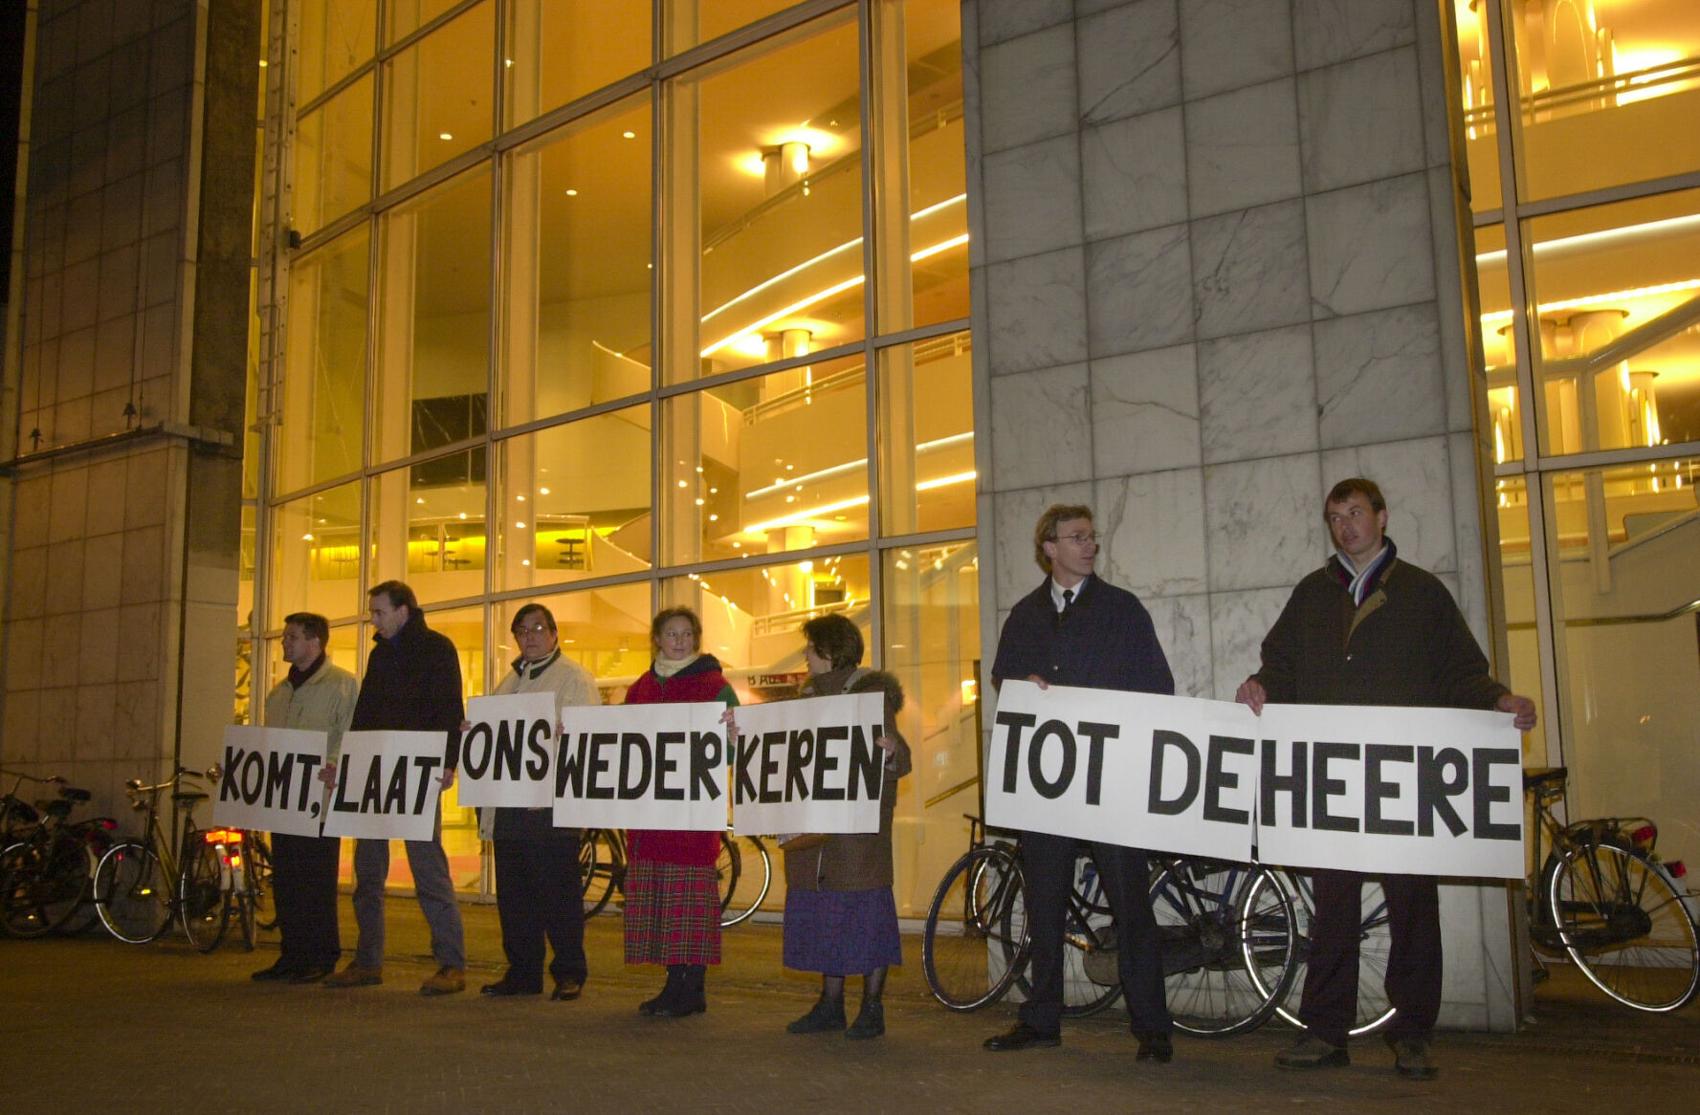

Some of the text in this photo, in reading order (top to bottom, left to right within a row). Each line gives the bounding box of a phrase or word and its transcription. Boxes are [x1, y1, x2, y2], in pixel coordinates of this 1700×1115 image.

[220, 747, 321, 818] KOMT,
[334, 754, 441, 815] LAAT
[462, 718, 550, 781] ONS
[555, 731, 721, 801] WEDER
[735, 724, 882, 805] KEREN
[996, 711, 1255, 825] TOT DE
[1260, 739, 1521, 841] HEERE
